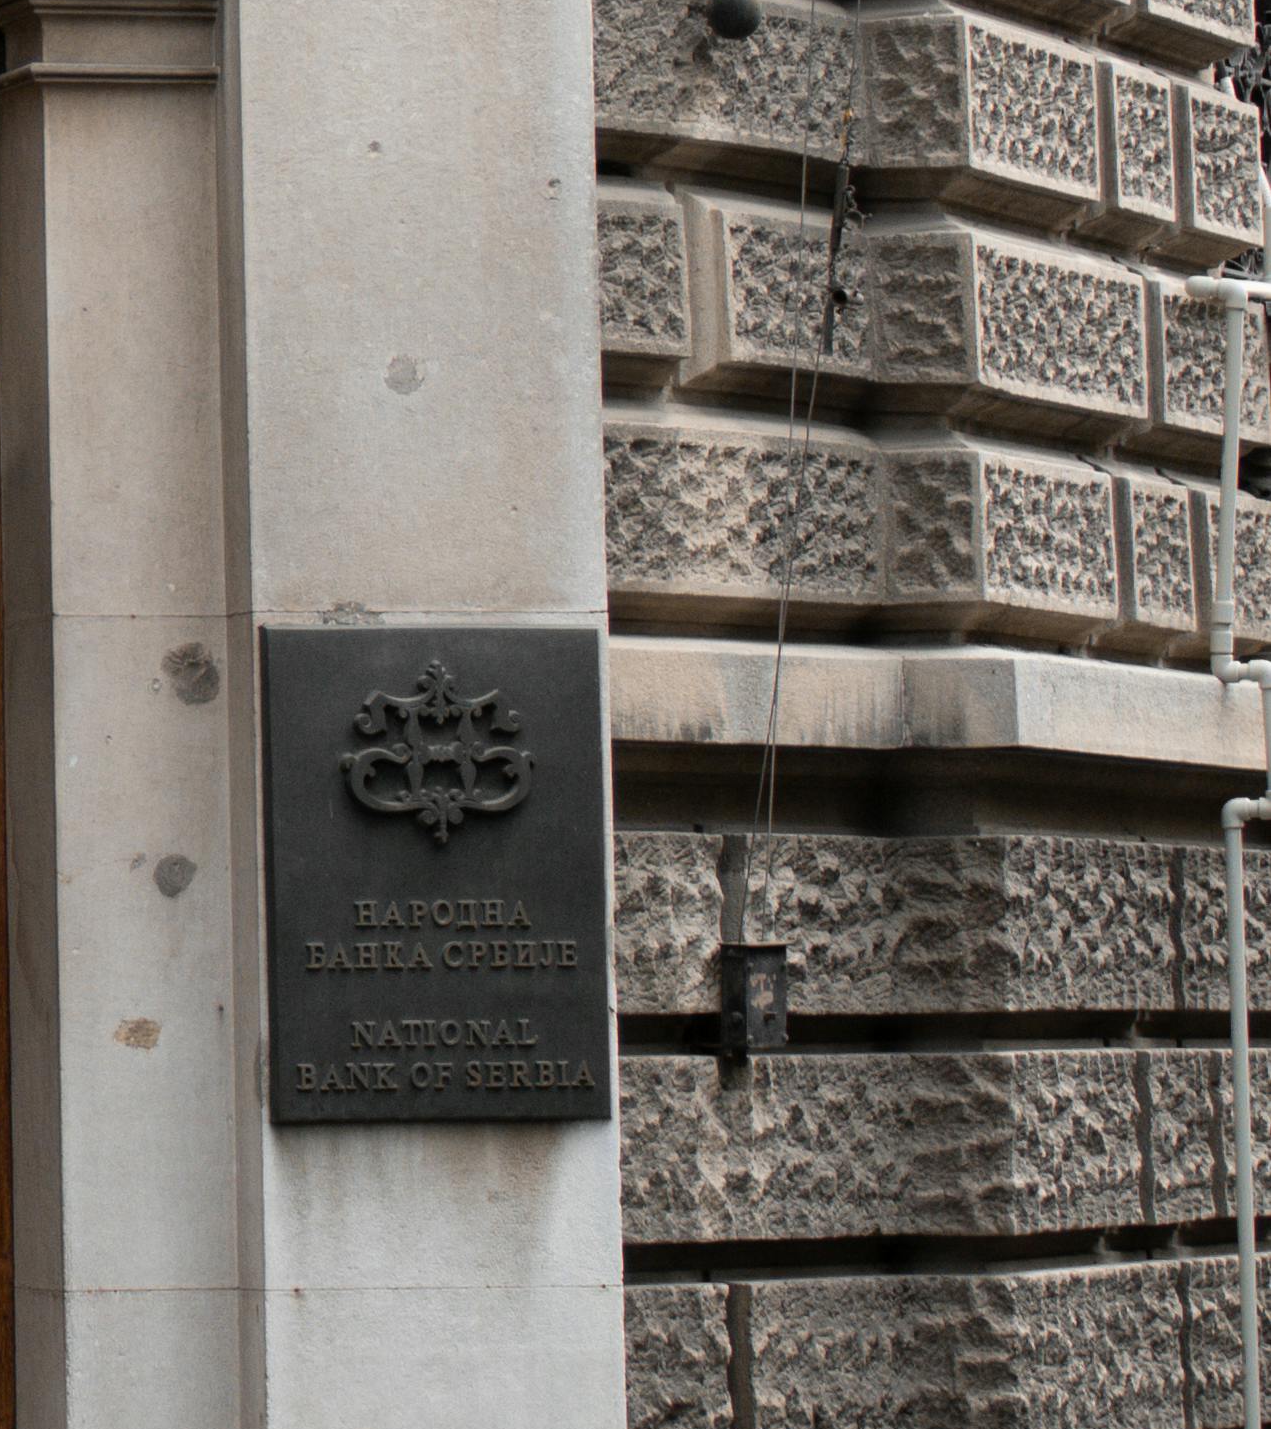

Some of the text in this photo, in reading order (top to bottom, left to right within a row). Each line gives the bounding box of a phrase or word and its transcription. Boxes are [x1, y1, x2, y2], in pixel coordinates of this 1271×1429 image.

[354, 899, 532, 930] НАРОДНА
[306, 940, 579, 970] БАНКА СРБИЈЕ
[351, 1018, 538, 1047] NATIONAL
[297, 1060, 596, 1091] BANK OF SERBIA
